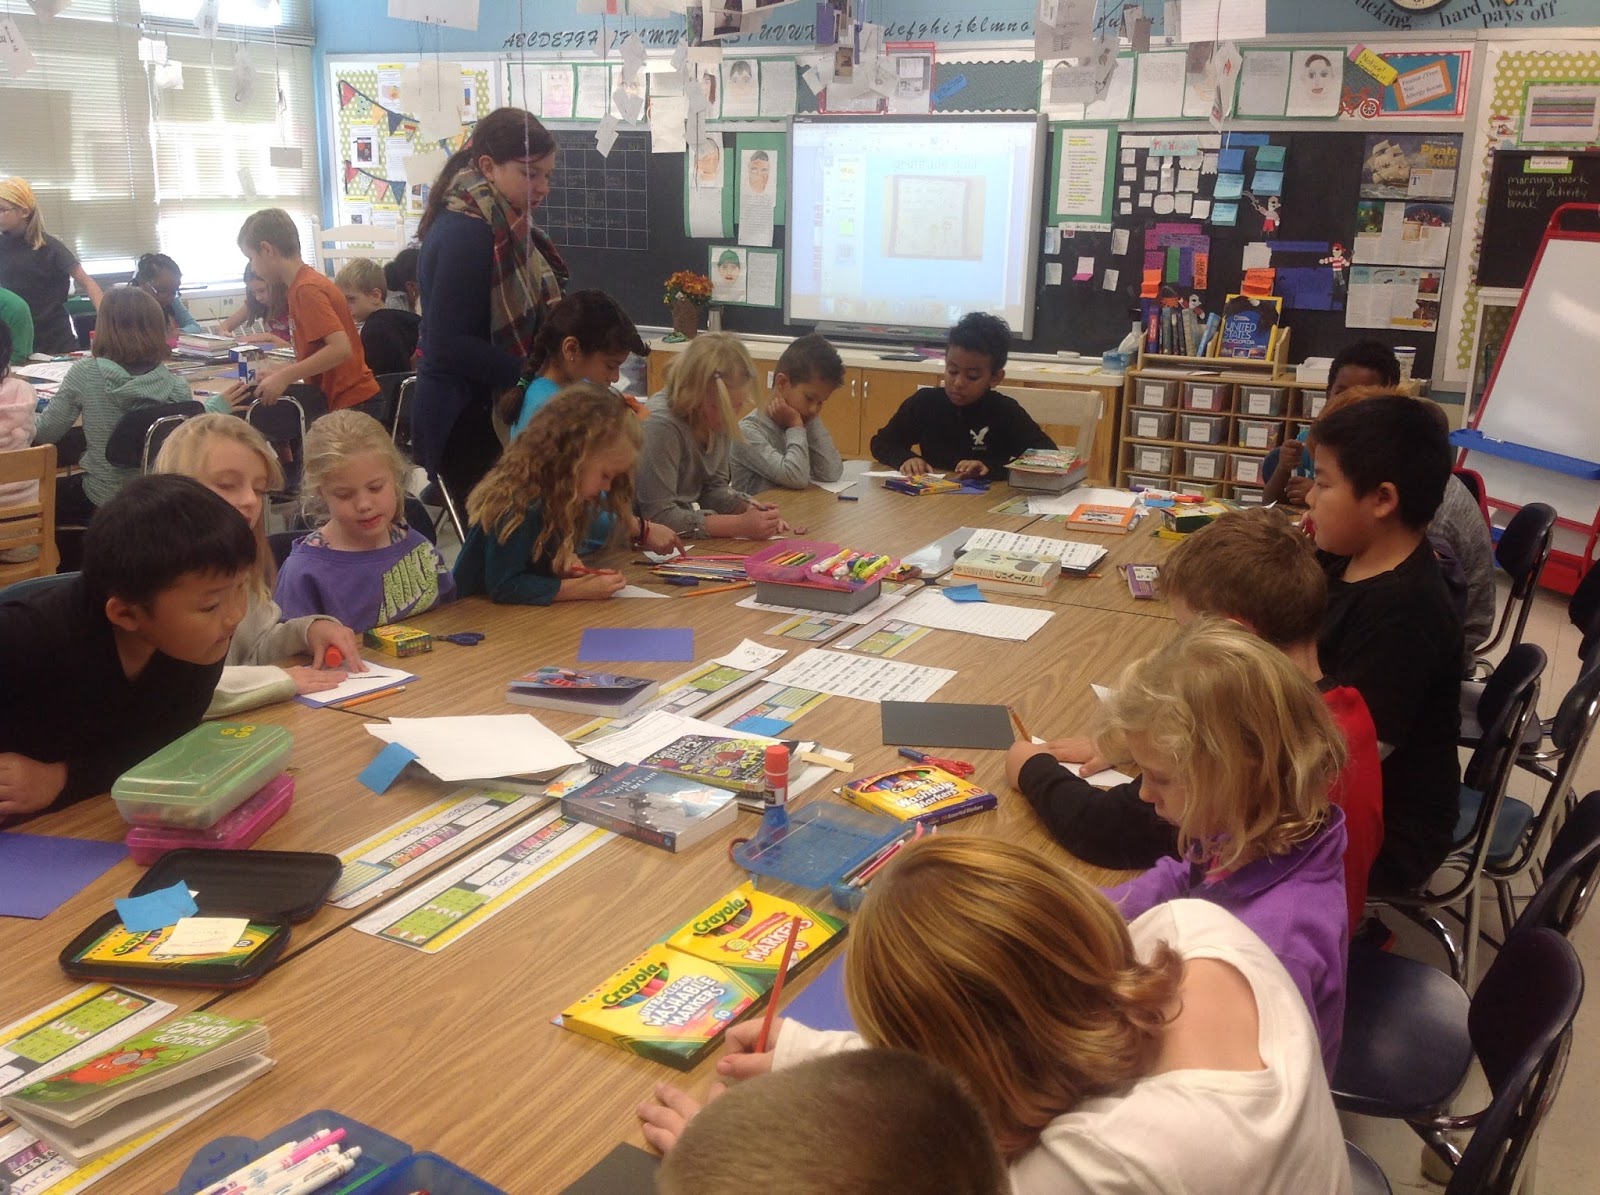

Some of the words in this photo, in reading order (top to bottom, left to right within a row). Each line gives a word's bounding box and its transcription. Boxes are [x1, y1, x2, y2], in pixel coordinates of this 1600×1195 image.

[1439, 0, 1481, 27] hard
[1482, 9, 1524, 29] pays
[1421, 144, 1458, 156] Pirate
[1507, 176, 1554, 190] morning
[1558, 176, 1589, 184] work
[1507, 198, 1537, 208] break
[1508, 187, 1539, 202] buddy
[1223, 330, 1252, 340] STATES
[1225, 321, 1257, 332] UNITED
[383, 541, 439, 619] NIKE
[625, 771, 658, 793] Curtain
[896, 781, 957, 808] Washable
[914, 788, 959, 810] Markers
[964, 787, 983, 796] 10
[692, 897, 747, 933] Crayola
[112, 932, 147, 954] Crayo
[601, 962, 661, 1005] Crayola
[639, 976, 694, 1017] ULTRA-CLEAN
[644, 975, 719, 1026] WASHABLE
[665, 985, 726, 1026] MARKERS
[714, 1009, 731, 1020] 10
[158, 1021, 247, 1038] ZOMBIE
